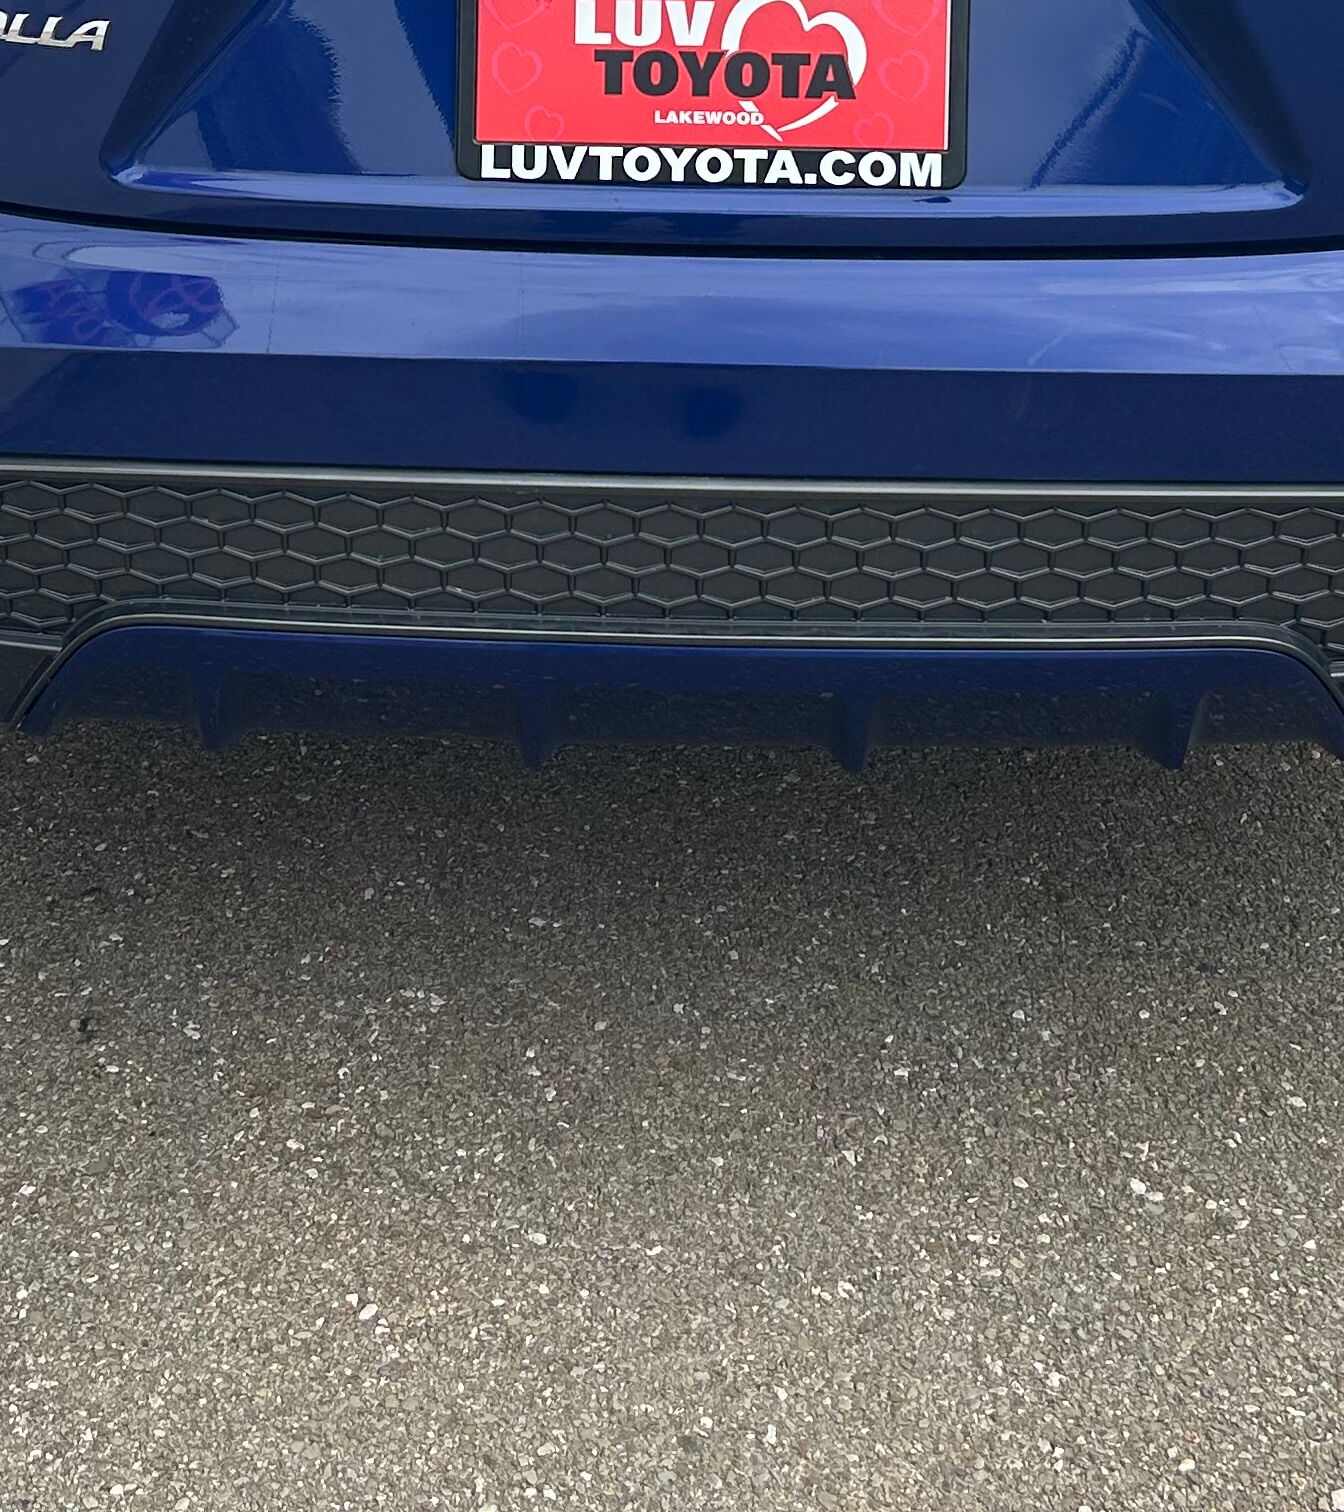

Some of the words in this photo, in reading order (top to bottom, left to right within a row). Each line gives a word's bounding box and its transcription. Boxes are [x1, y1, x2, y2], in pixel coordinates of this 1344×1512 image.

[593, 49, 856, 100] TOYOTA
[654, 110, 764, 126] LAKEWOOD
[481, 144, 943, 188] LUVTOYOTA.COM
